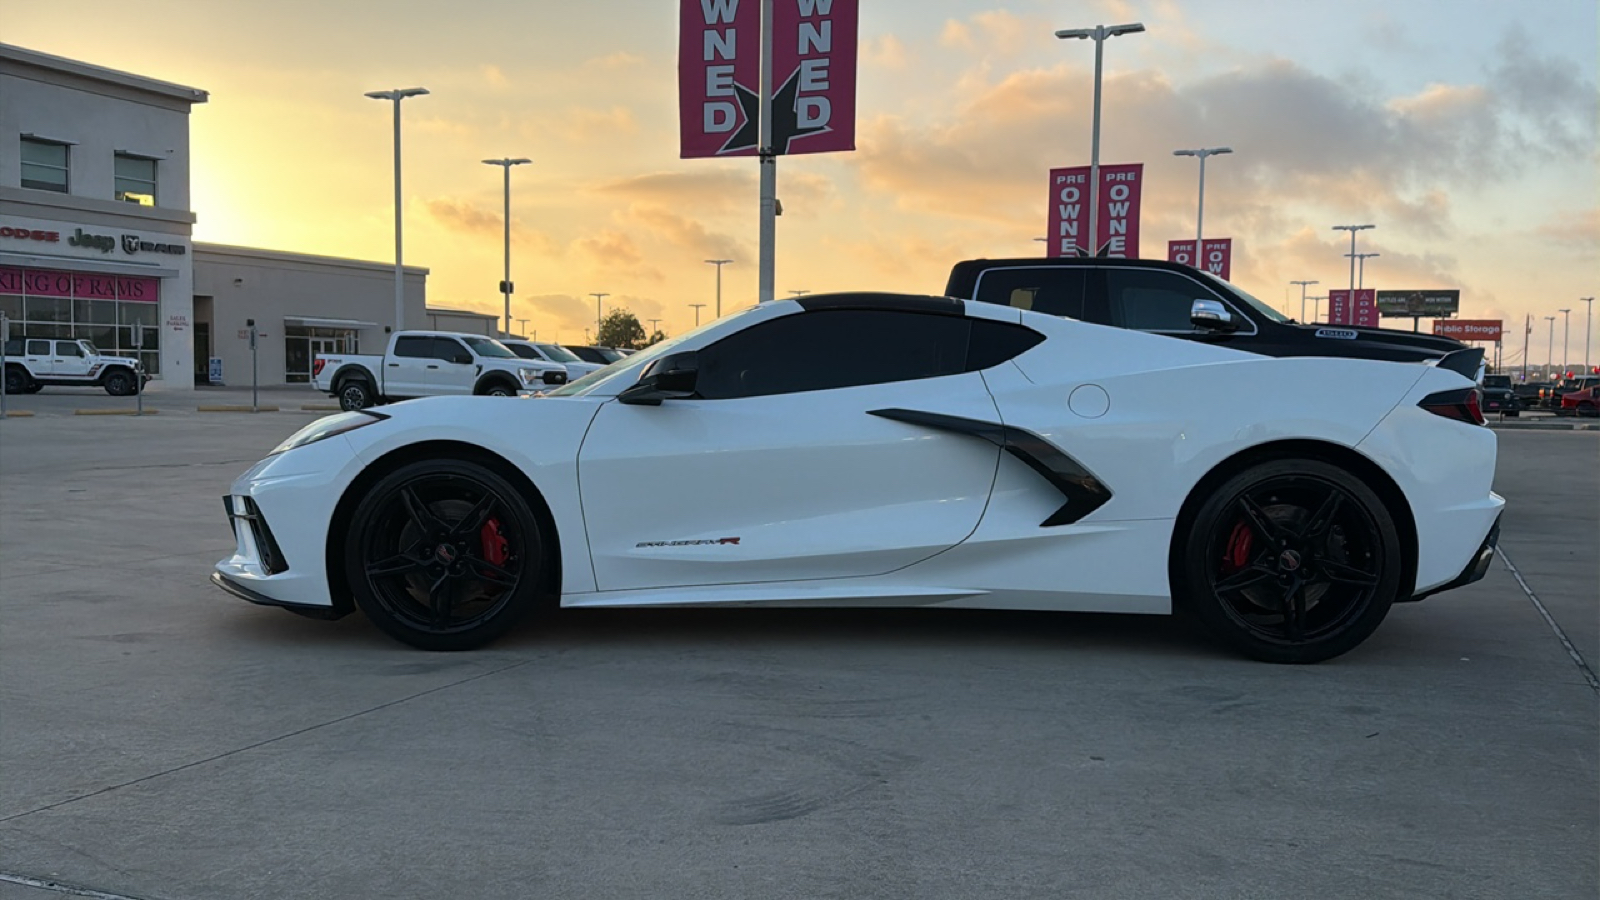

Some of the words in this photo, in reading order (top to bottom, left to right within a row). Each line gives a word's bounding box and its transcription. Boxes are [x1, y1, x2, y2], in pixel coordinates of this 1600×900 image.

[1057, 174, 1085, 184] PRE
[1106, 172, 1135, 182] PRE
[1058, 186, 1080, 258] OWNE
[1108, 184, 1130, 259] OWNE
[68, 228, 115, 253] Jeep
[141, 242, 186, 255] RAM
[56, 273, 82, 295] OF
[90, 278, 144, 298] RAMS
[1465, 325, 1500, 335] Storage
